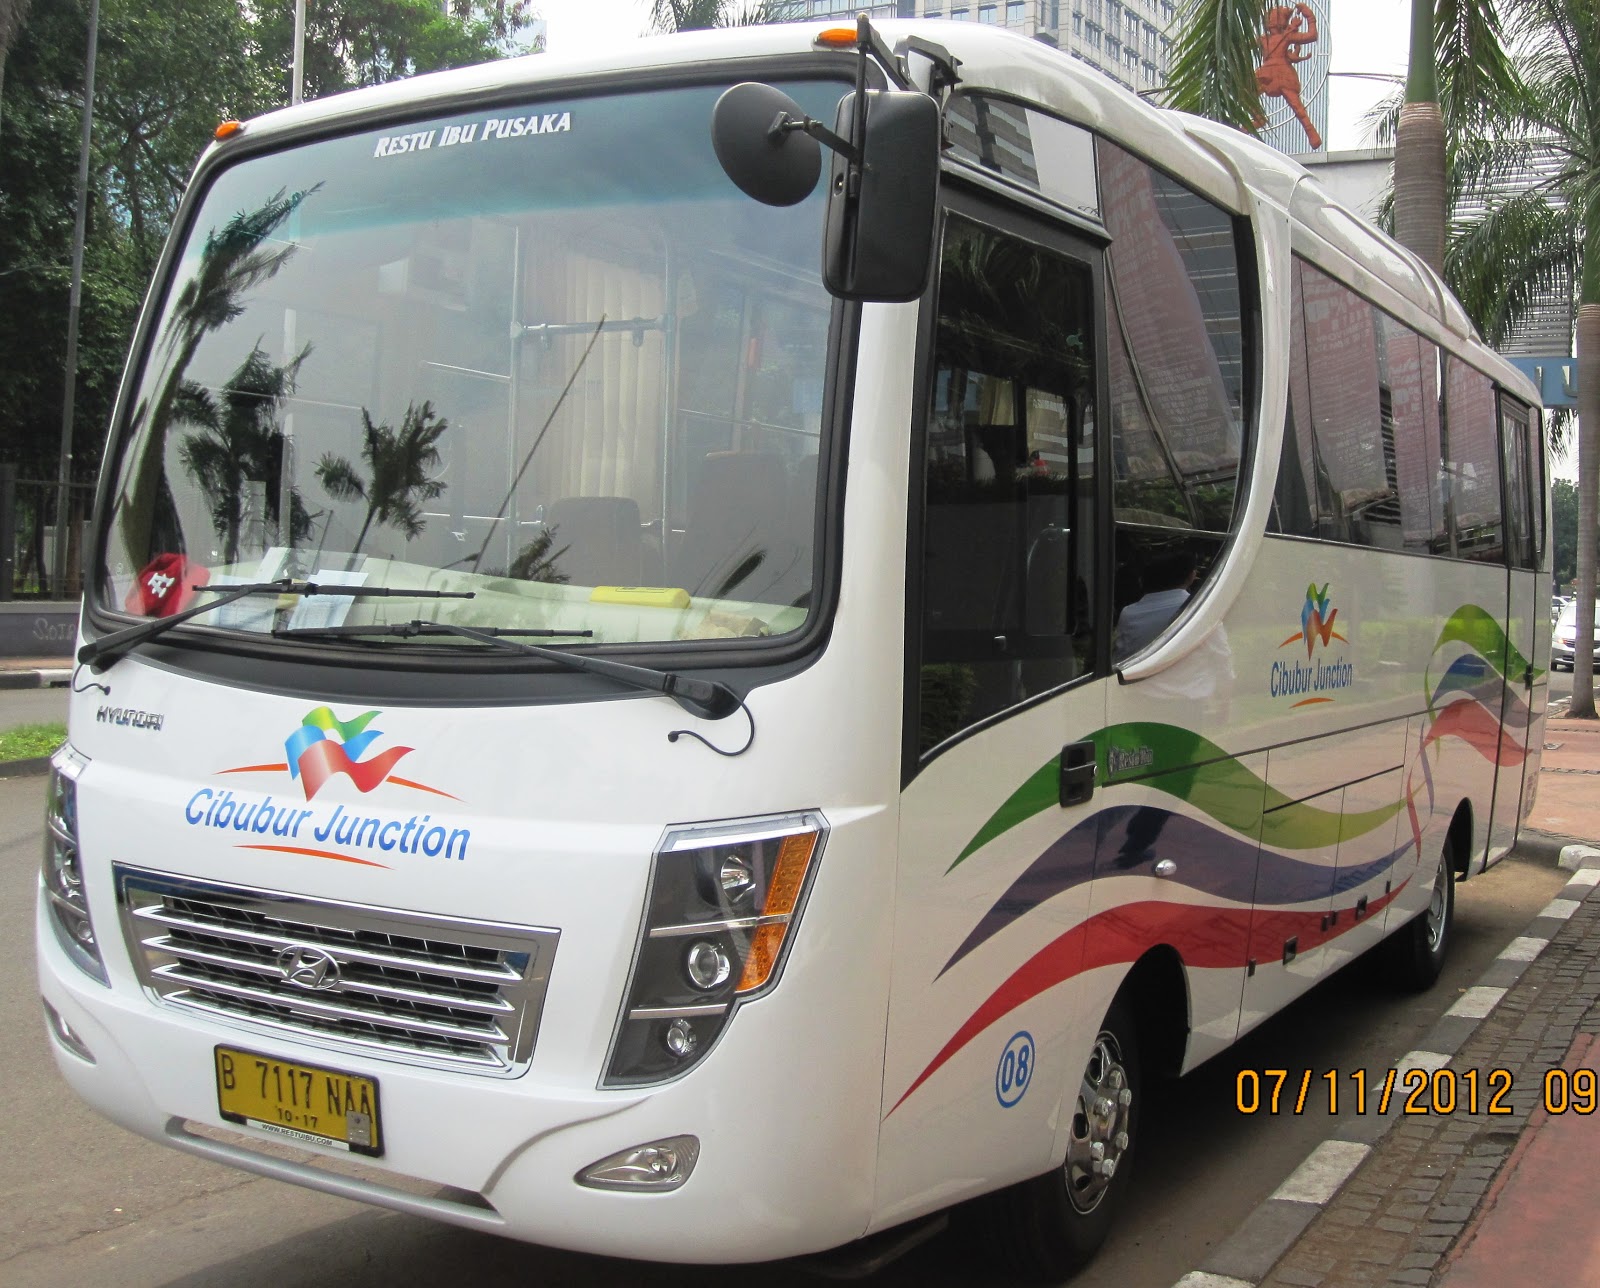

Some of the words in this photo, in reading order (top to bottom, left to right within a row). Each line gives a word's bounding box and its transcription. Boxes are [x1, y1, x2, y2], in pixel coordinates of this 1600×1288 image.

[373, 130, 436, 158] RESTU
[438, 123, 478, 147] IBU
[480, 112, 571, 141] PUSAKA
[1270, 660, 1312, 697] Cibubur
[1313, 656, 1353, 692] Junction
[96, 705, 164, 731] HYUNDAI
[185, 788, 313, 838] Cibubur
[314, 804, 471, 861] Junction
[220, 1053, 236, 1090] B
[255, 1061, 313, 1109] 7117
[326, 1075, 373, 1124] NAA
[1001, 1044, 1030, 1093] 08
[261, 1124, 333, 1146] WWW.RESTUIBU.COM
